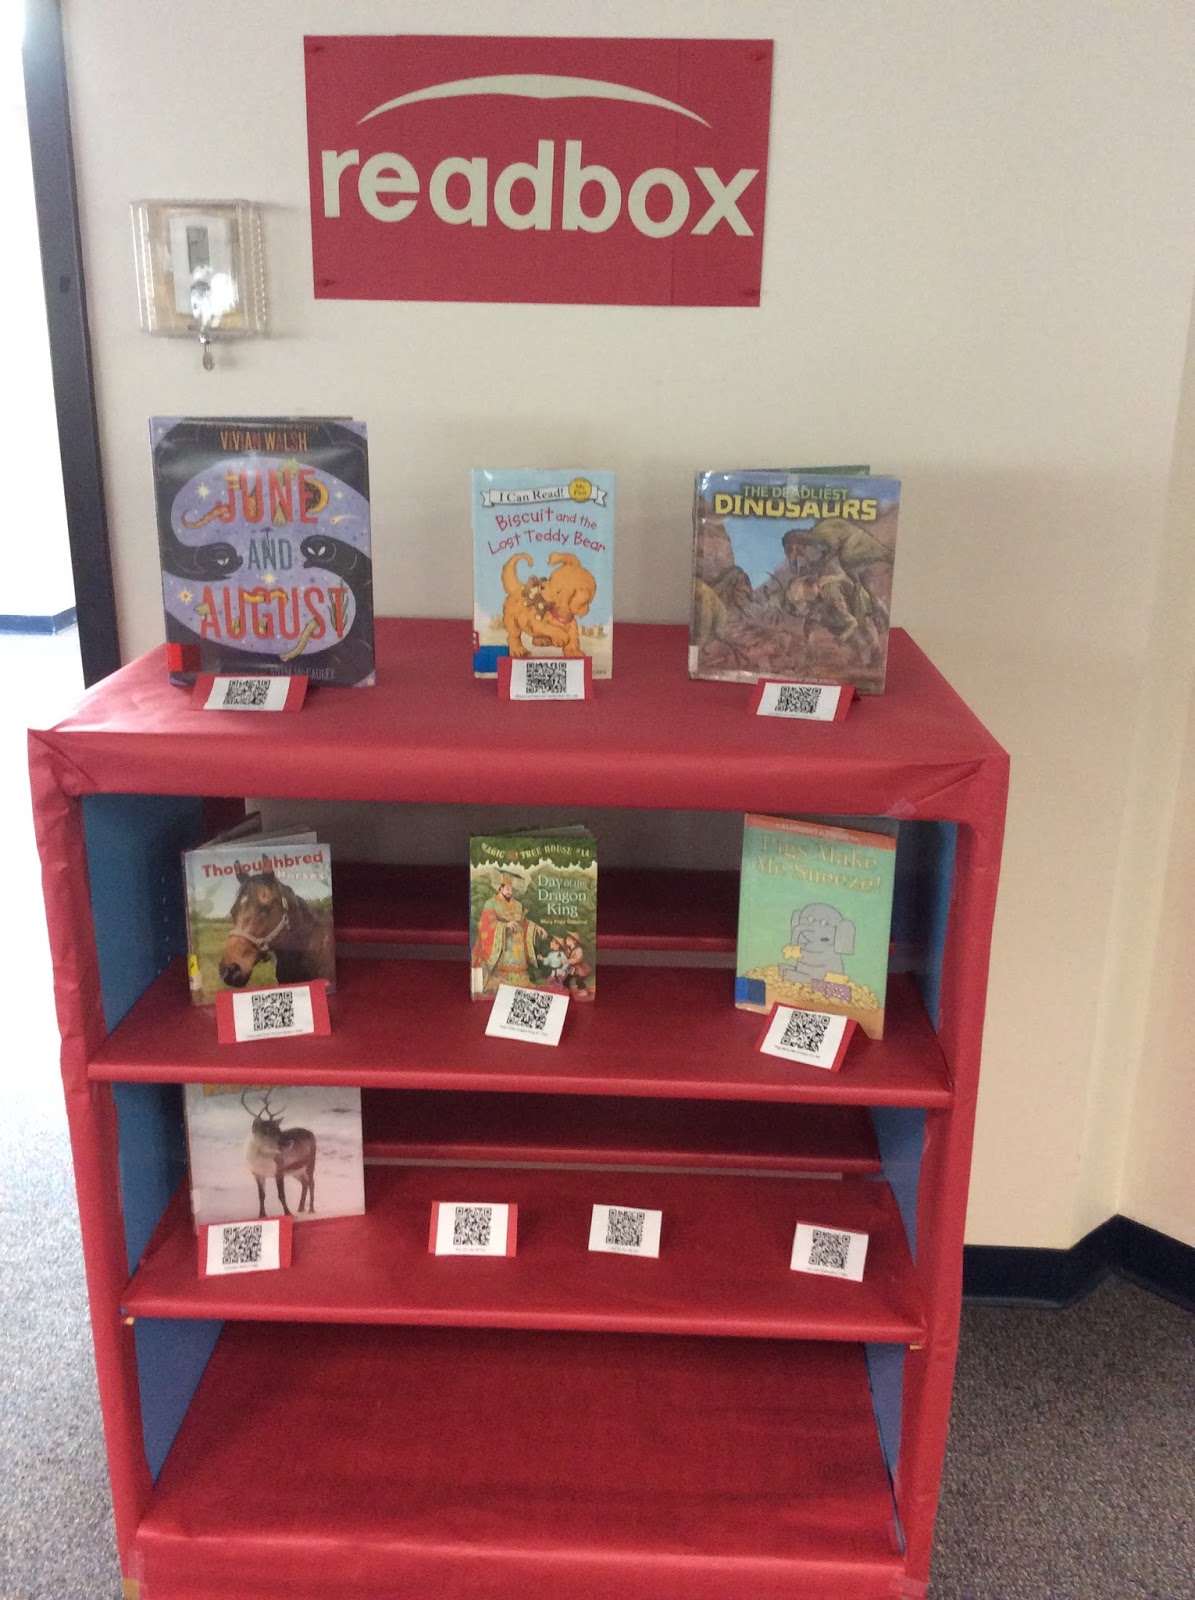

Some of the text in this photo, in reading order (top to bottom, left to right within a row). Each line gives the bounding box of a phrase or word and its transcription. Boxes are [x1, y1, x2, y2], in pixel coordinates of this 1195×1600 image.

[321, 139, 760, 239] readbox
[264, 432, 308, 451] WALSH
[214, 467, 319, 525] JUNE
[499, 488, 564, 502] I Can Read!
[742, 486, 849, 501] THE DEADLIEST
[495, 507, 598, 532] Biscuit and the
[714, 493, 878, 521] DINOSAURS
[247, 537, 293, 571] AND
[487, 528, 606, 556] Lost Teddy Bear
[199, 585, 349, 640] AUGUST
[481, 842, 505, 859] MAGIC
[520, 847, 543, 860] TREE
[544, 844, 573, 856] HOUSE
[818, 844, 877, 870] Make
[202, 850, 324, 878] Thoroughbred
[277, 870, 325, 880] Horses
[538, 875, 564, 889] Day
[538, 888, 587, 904] Dragon
[547, 903, 579, 918] King
